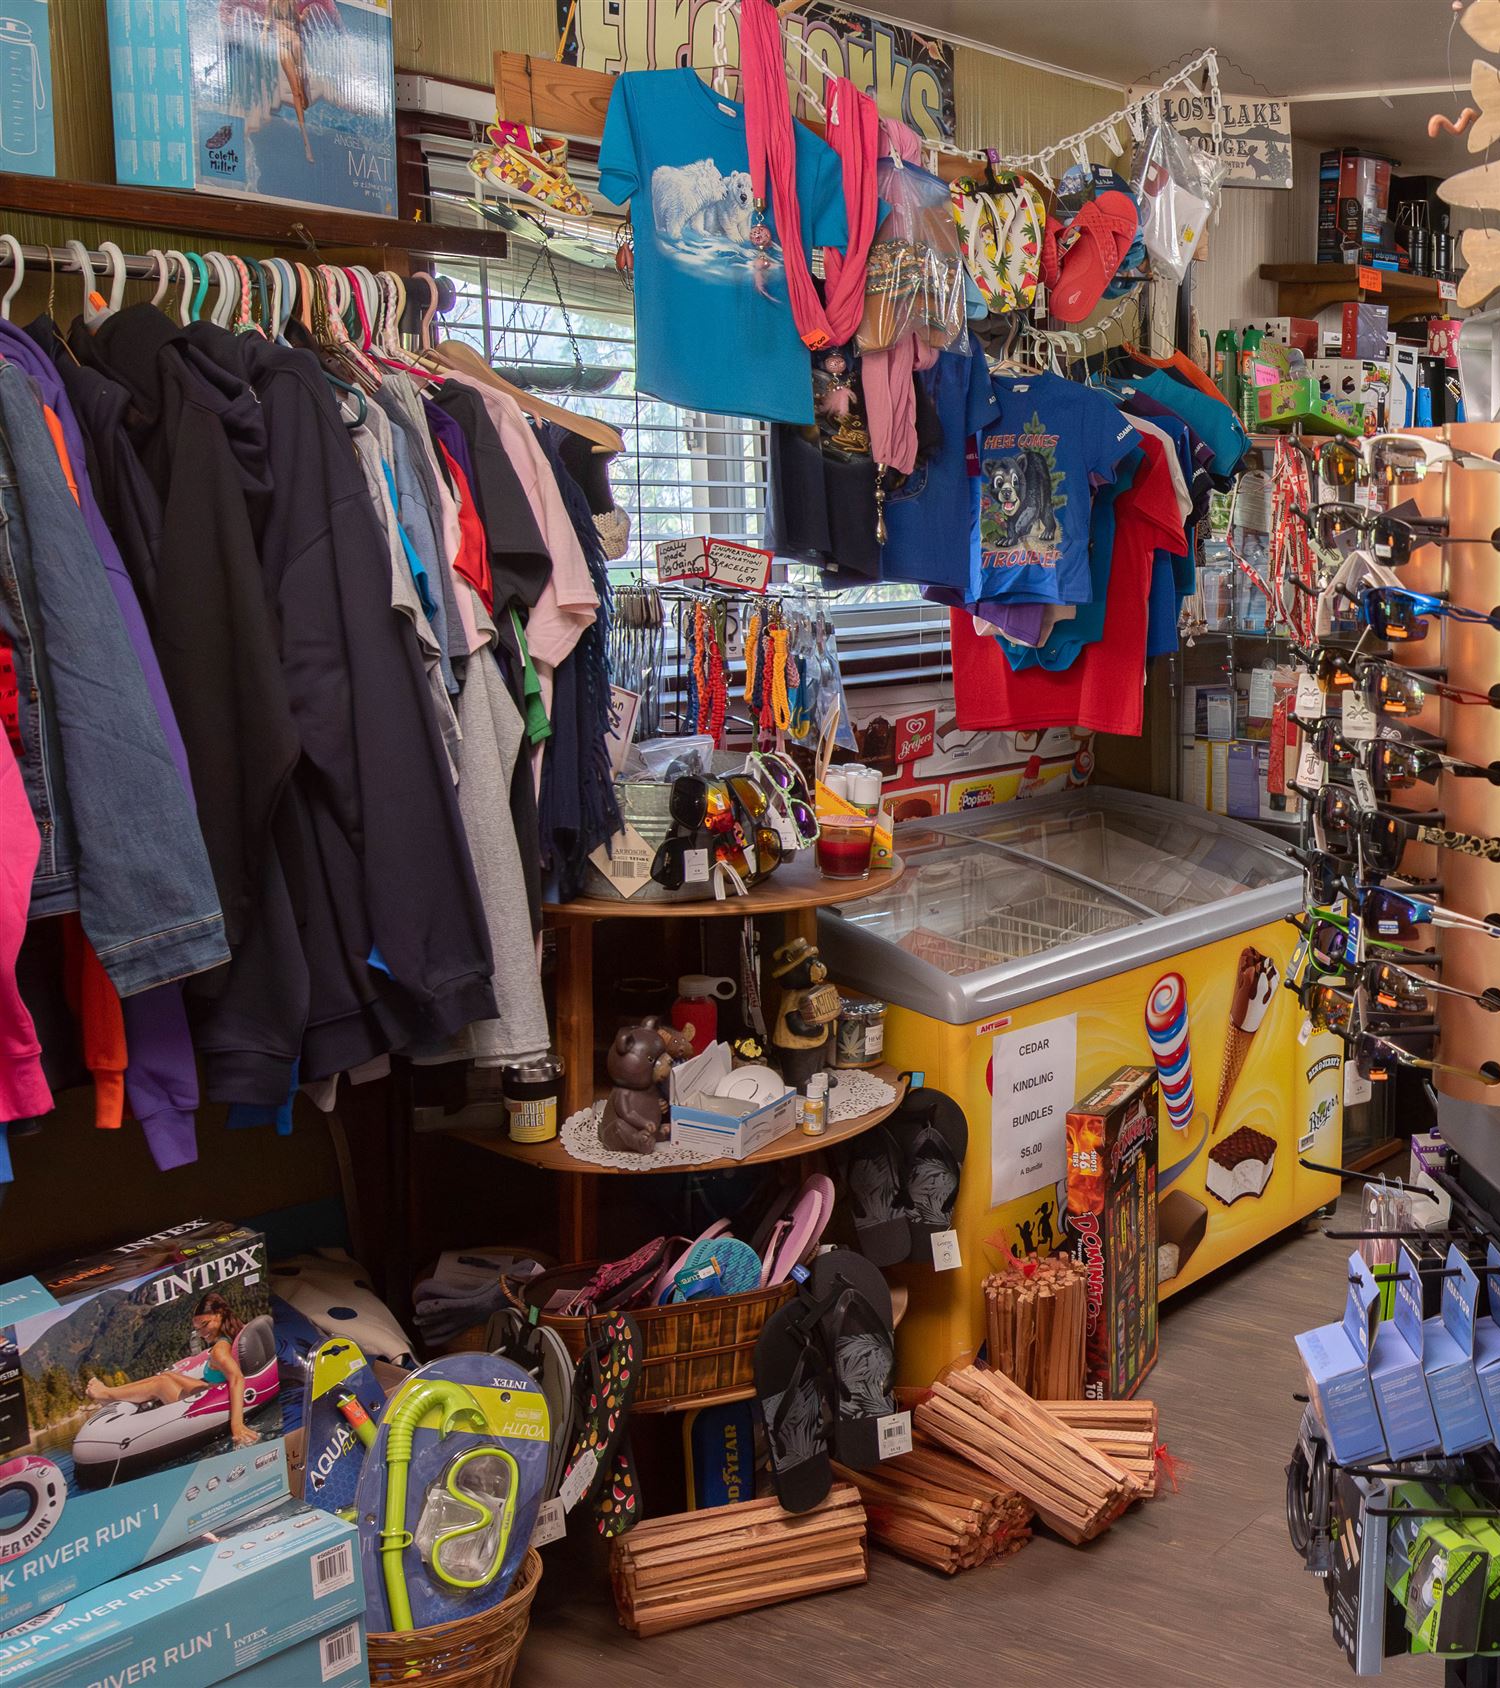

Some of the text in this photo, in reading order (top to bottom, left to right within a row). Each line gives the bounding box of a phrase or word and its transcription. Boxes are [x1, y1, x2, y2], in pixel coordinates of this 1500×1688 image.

[1163, 96, 1282, 127] LOST LAKE
[208, 149, 239, 164] Colette
[209, 160, 237, 173] Miller
[348, 150, 393, 181] MAT
[984, 434, 1060, 450] HERE COMES
[1116, 424, 1133, 442] ADAMS
[711, 558, 758, 573] BRACELET
[897, 731, 933, 760] Breyers
[980, 1023, 995, 1034] AHT
[1019, 1038, 1050, 1056] CEDAR
[1012, 1071, 1054, 1093] KINDLING
[1012, 1105, 1053, 1128] BUNDLES
[1020, 1142, 1043, 1159] $5.00
[1072, 1151, 1080, 1168] TIRS
[1080, 1151, 1090, 1170] 46
[1020, 1162, 1043, 1176] A Bundle
[113, 1216, 211, 1255] INTEX
[48, 1264, 115, 1289] LOUNGE
[151, 1243, 262, 1306] INTEX
[492, 1377, 528, 1390] INTEX
[502, 1421, 545, 1438] YOUTH
[309, 1427, 350, 1494] AQUA
[152, 1503, 160, 1521] 1
[24, 1516, 52, 1547] RUN
[95, 1511, 142, 1548] RUN
[22, 1536, 90, 1584] RIVER
[1459, 1554, 1483, 1584] CHARGER
[127, 1573, 183, 1601] RUN
[1446, 1579, 1459, 1597] USB
[50, 1598, 128, 1635] RIVER
[224, 1622, 232, 1640] 1
[233, 1626, 268, 1650] INTEX
[163, 1630, 213, 1668] RUN
